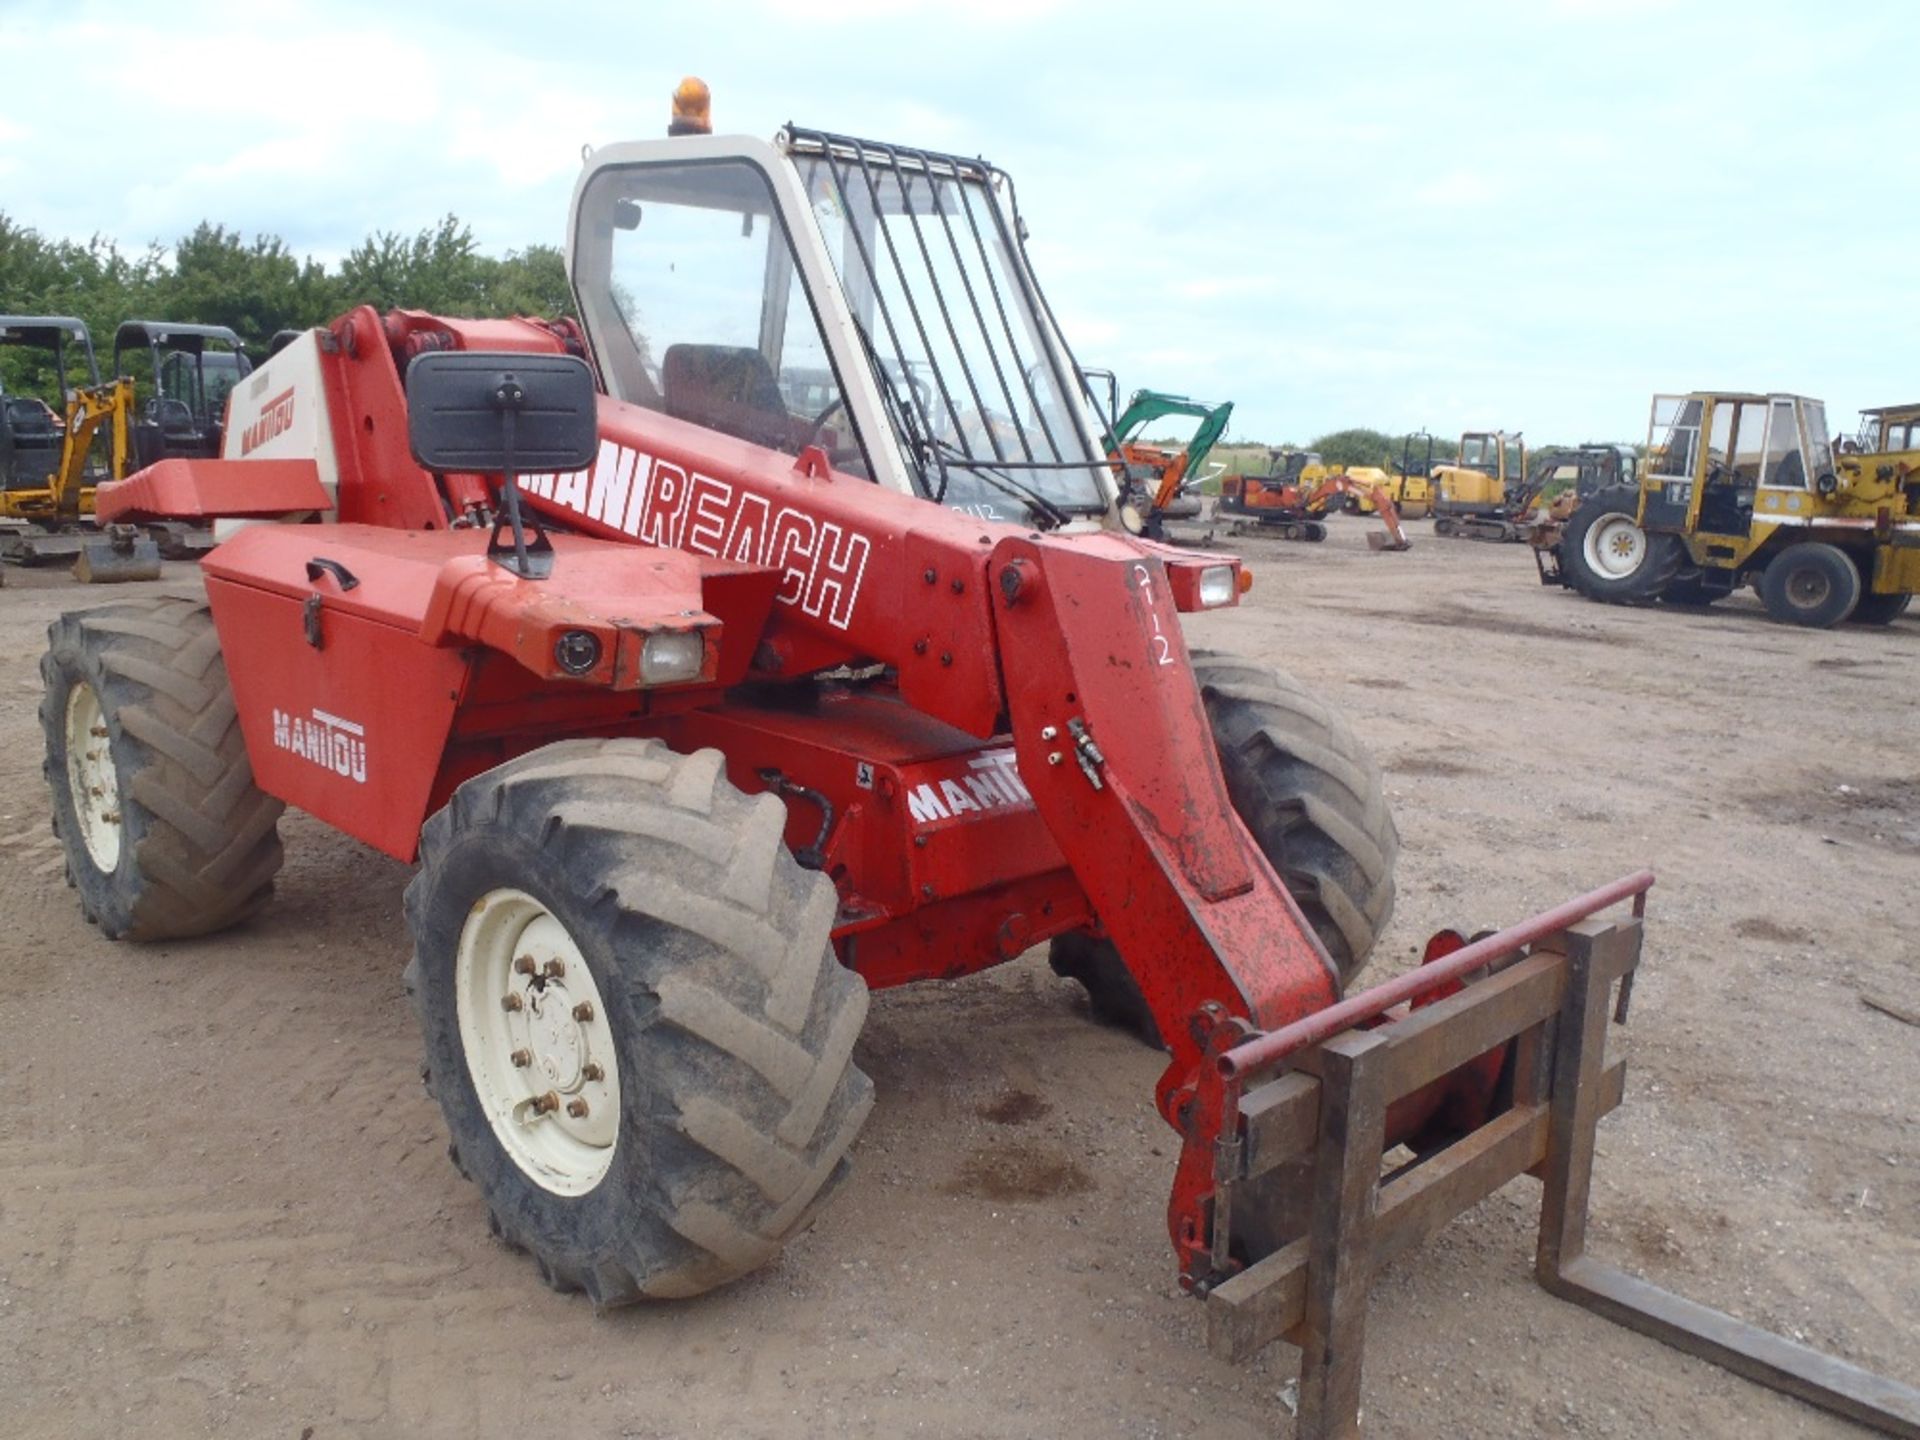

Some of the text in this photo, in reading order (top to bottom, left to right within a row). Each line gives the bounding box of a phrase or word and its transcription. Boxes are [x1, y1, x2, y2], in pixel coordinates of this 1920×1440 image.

[241, 385, 294, 457] MANITOU
[1134, 563, 1174, 665] 2112
[272, 707, 366, 784] MANITOU
[907, 747, 1033, 823] MANIT
